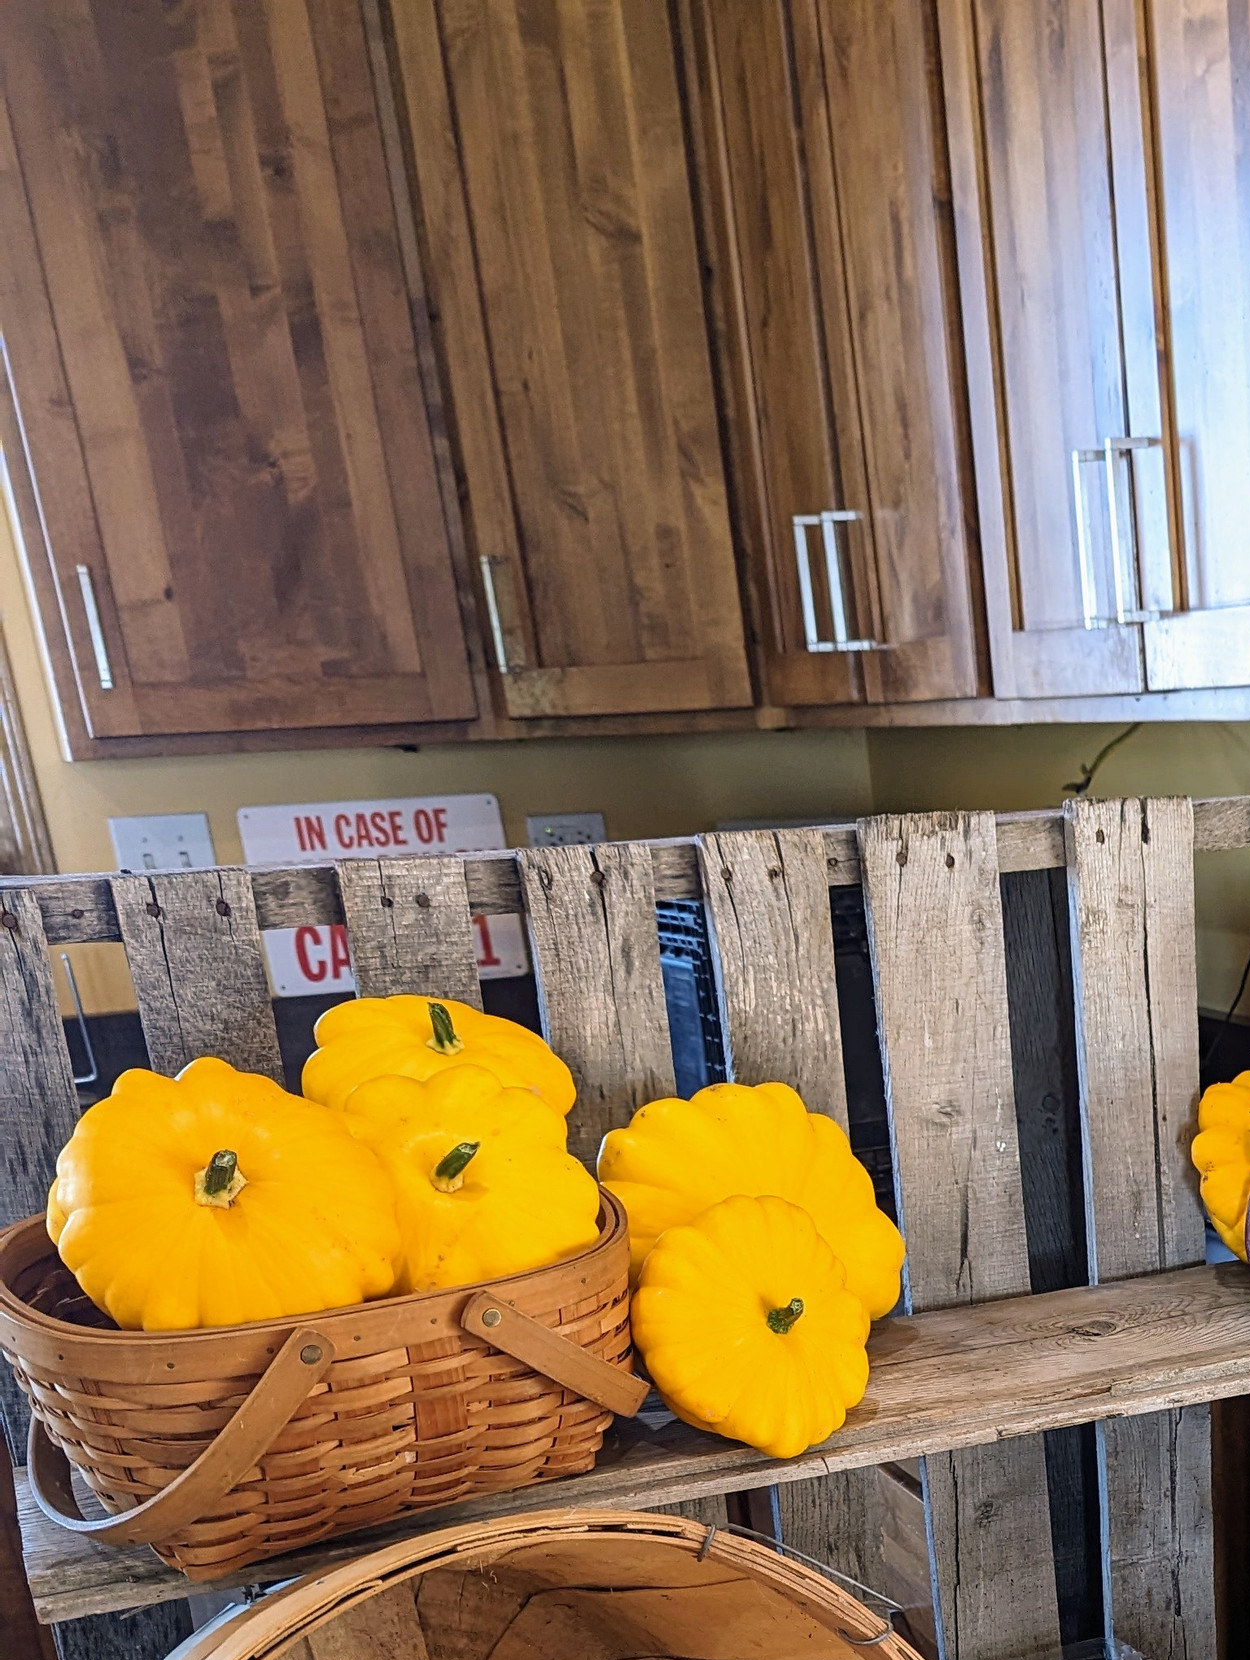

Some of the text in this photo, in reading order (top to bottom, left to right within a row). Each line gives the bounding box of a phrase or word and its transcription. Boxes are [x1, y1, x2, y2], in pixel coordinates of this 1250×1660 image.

[294, 808, 447, 851] IN CASE OF
[295, 924, 352, 982] CA
